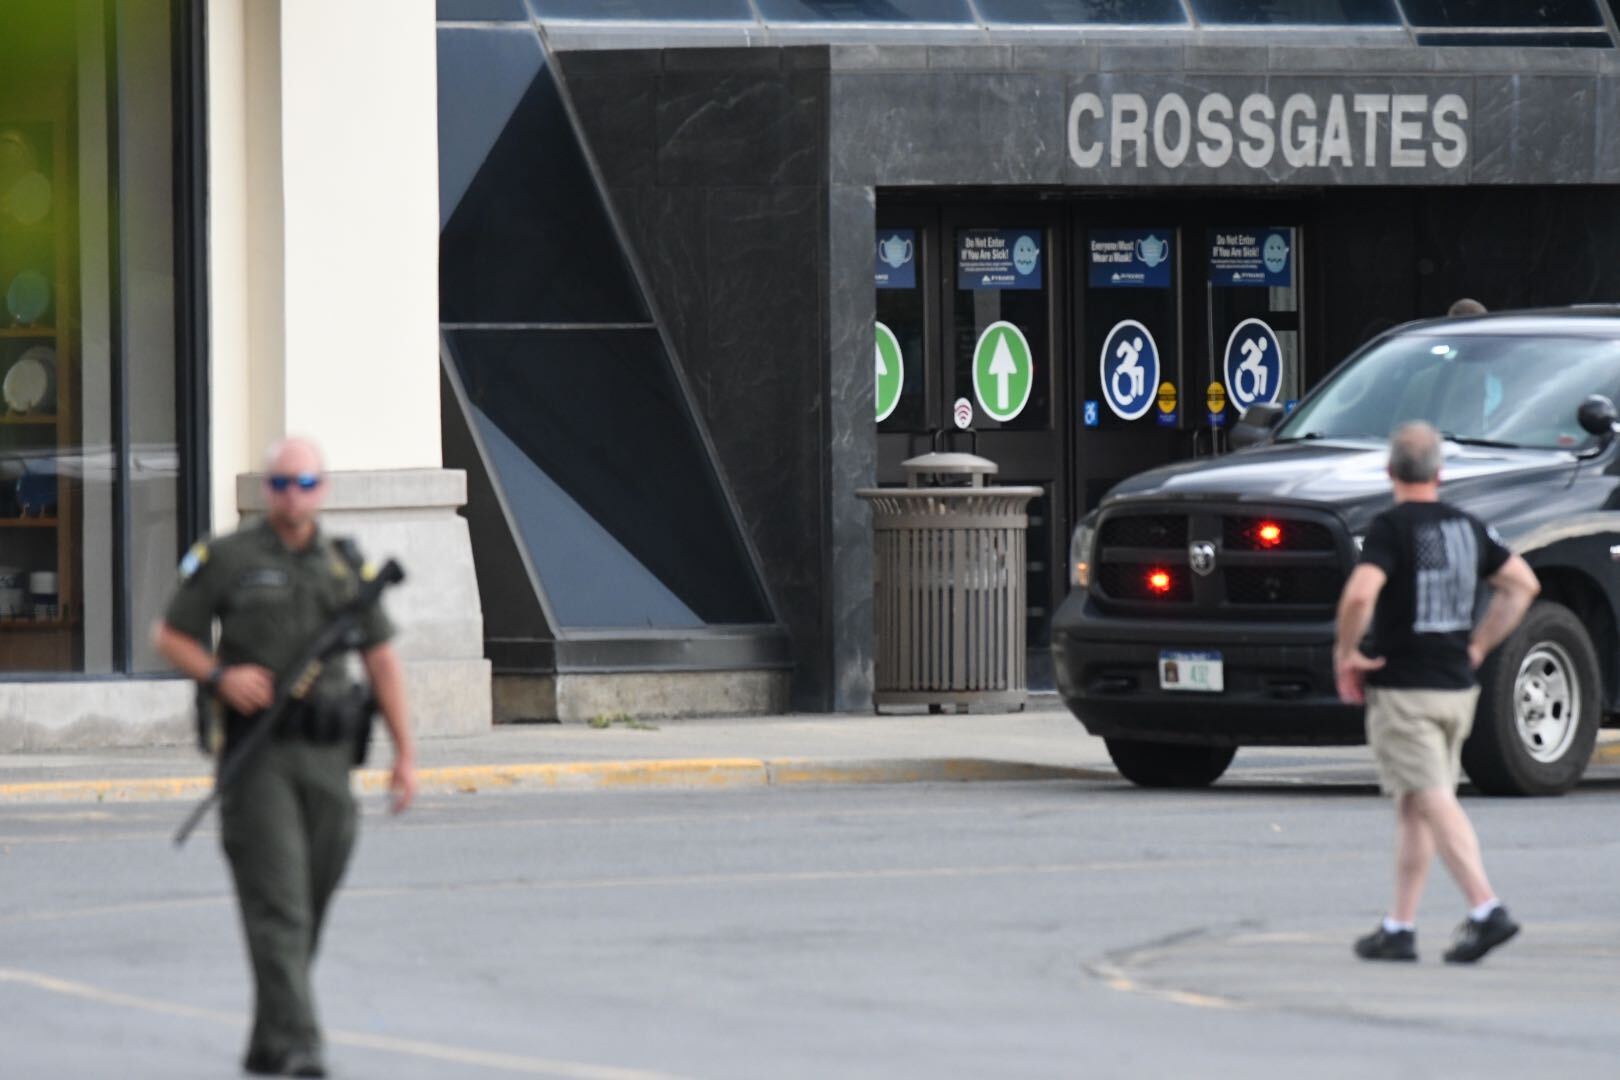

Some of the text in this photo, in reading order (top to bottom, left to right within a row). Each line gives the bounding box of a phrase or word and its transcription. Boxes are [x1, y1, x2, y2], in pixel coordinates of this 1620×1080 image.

[1067, 92, 1469, 168] CROSSGATES
[965, 237, 1005, 248] Do Not Enter
[1216, 234, 1256, 245] Do Not Enter
[968, 249, 979, 260] You
[980, 249, 991, 260] Are
[992, 249, 1009, 260] Sick!
[1219, 246, 1230, 257] You
[1231, 246, 1242, 257] Are
